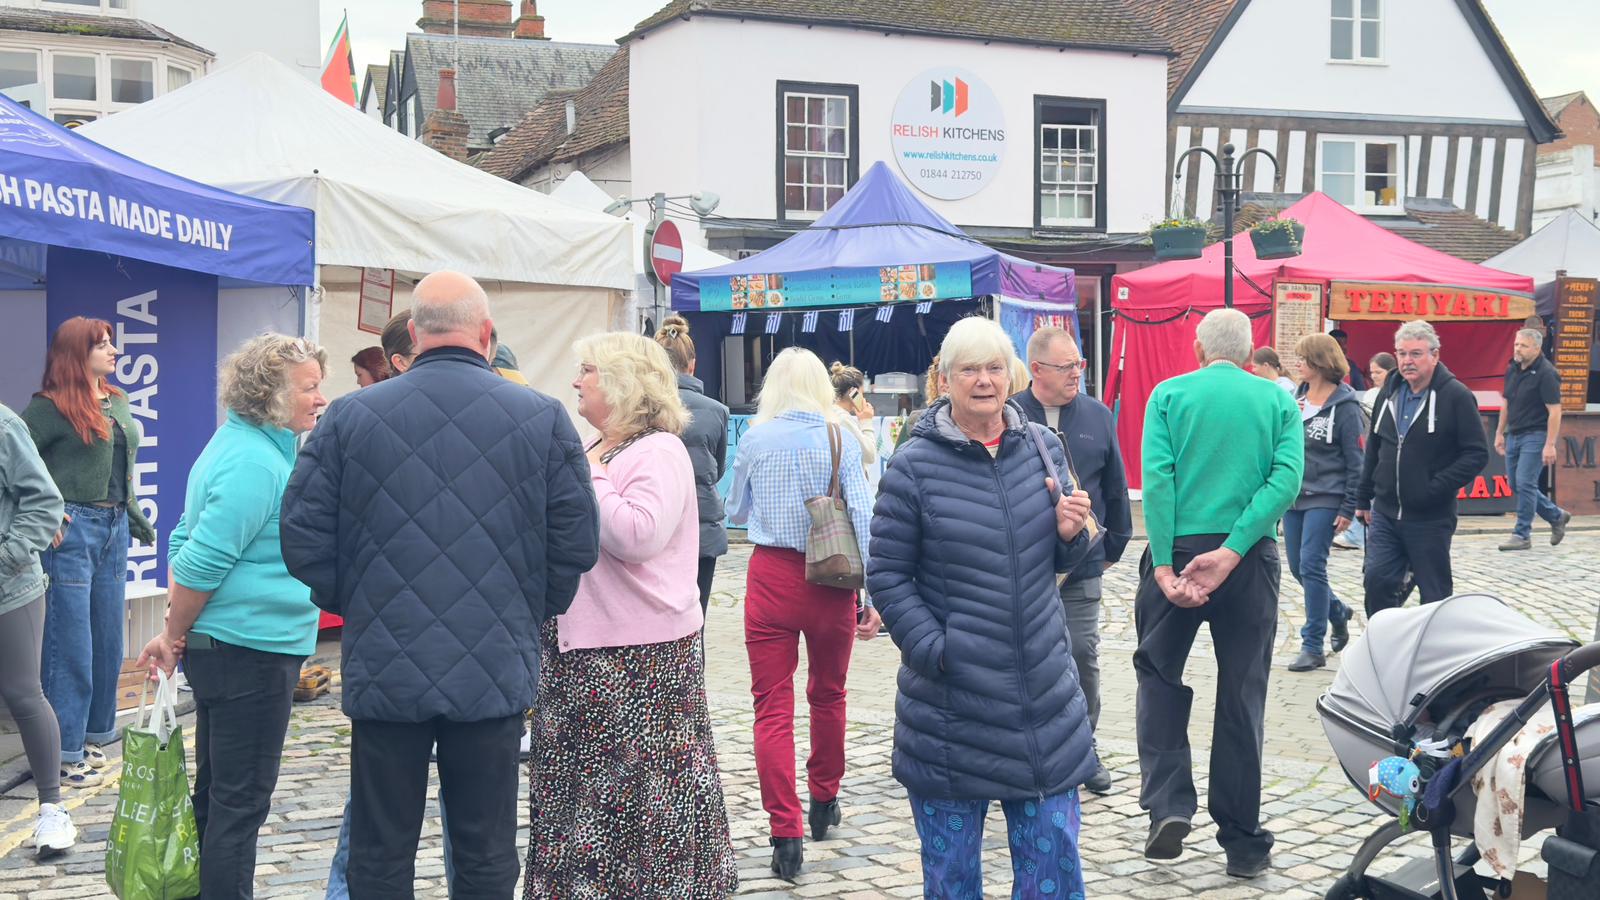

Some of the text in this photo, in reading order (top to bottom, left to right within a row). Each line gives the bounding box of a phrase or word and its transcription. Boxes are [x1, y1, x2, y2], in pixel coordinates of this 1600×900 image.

[893, 124, 1005, 141] RELISH KITCHENS
[903, 150, 998, 162] www.relishkitchens.co.uk
[920, 168, 982, 180] 01844 212750
[0, 173, 233, 251] H PASTA MADE DAILY
[1345, 289, 1512, 317] TERIYAKI
